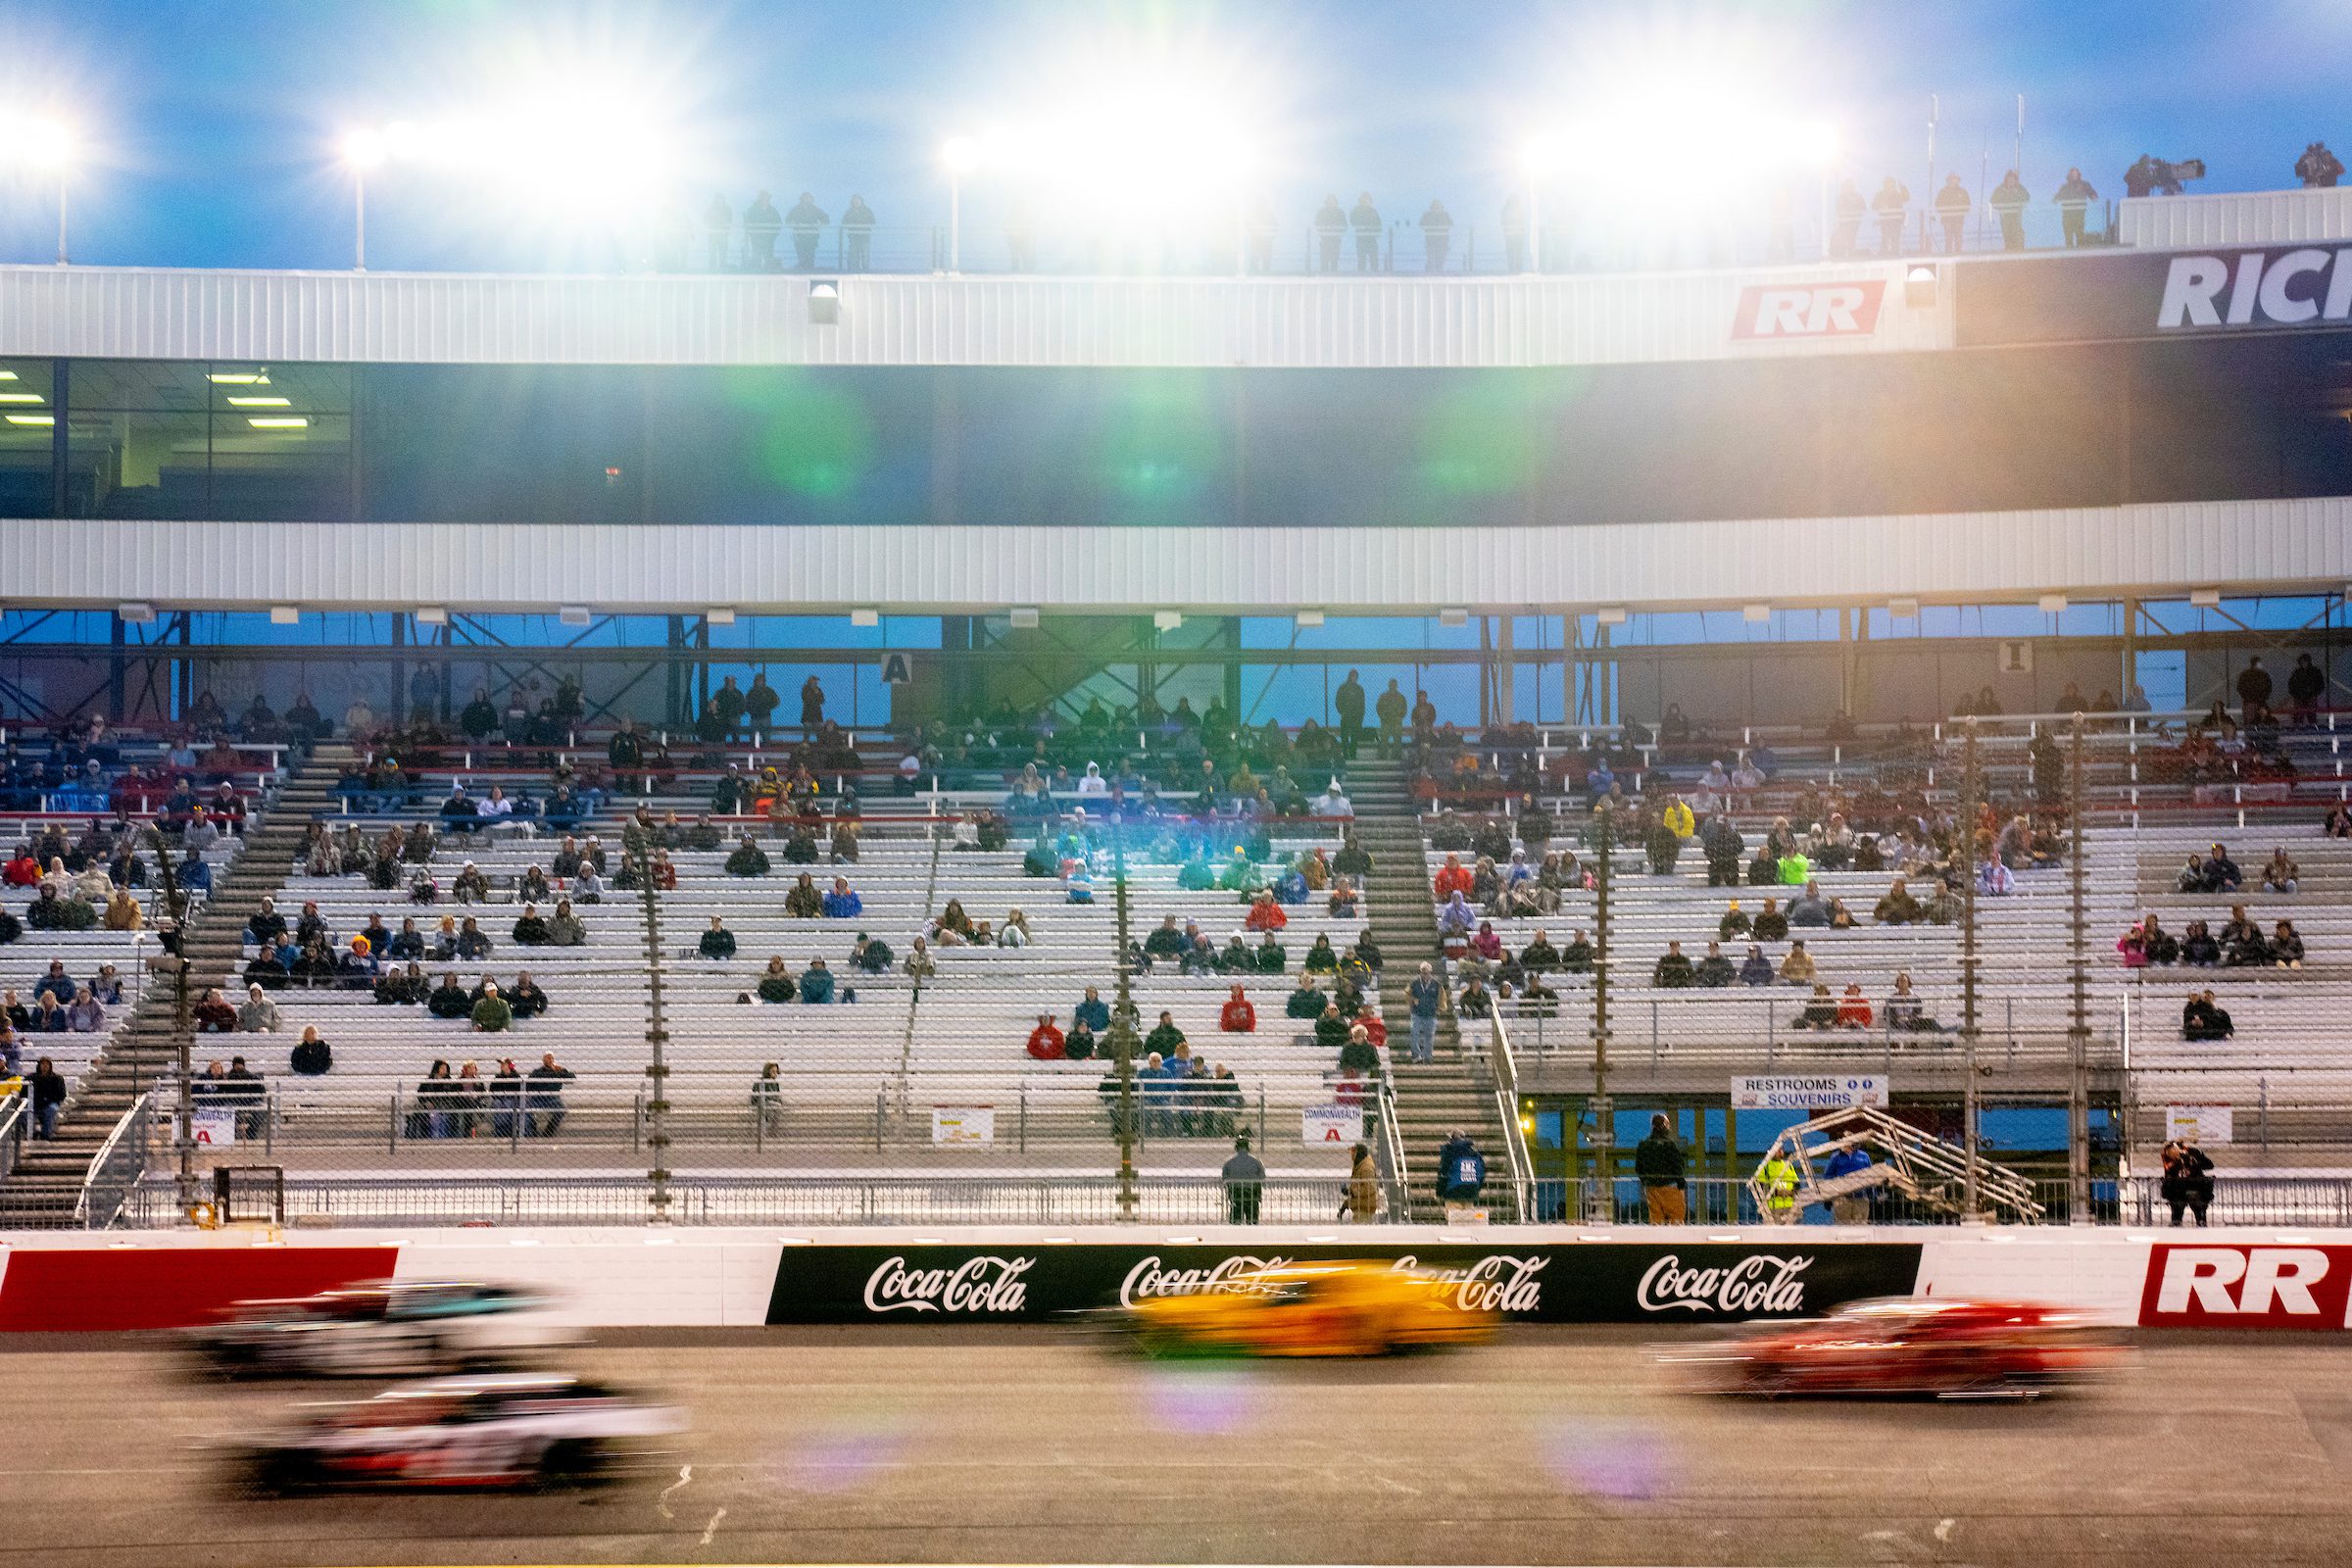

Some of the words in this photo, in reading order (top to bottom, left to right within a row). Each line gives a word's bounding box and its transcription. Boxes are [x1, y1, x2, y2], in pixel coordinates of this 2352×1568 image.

[1754, 287, 1864, 333] RR
[883, 656, 909, 682] A
[1746, 1079, 1837, 1091] RESTROOMS
[1768, 1094, 1851, 1105] SOUVENIRS
[1304, 1108, 1360, 1119] COMMONWEALTH
[1325, 1129, 1341, 1142] A
[863, 1255, 1037, 1312] Coca-Cola
[1390, 1255, 1551, 1311] ca-Cola
[1638, 1254, 1815, 1312] Coca-Cola
[2157, 1249, 2330, 1315] RR
